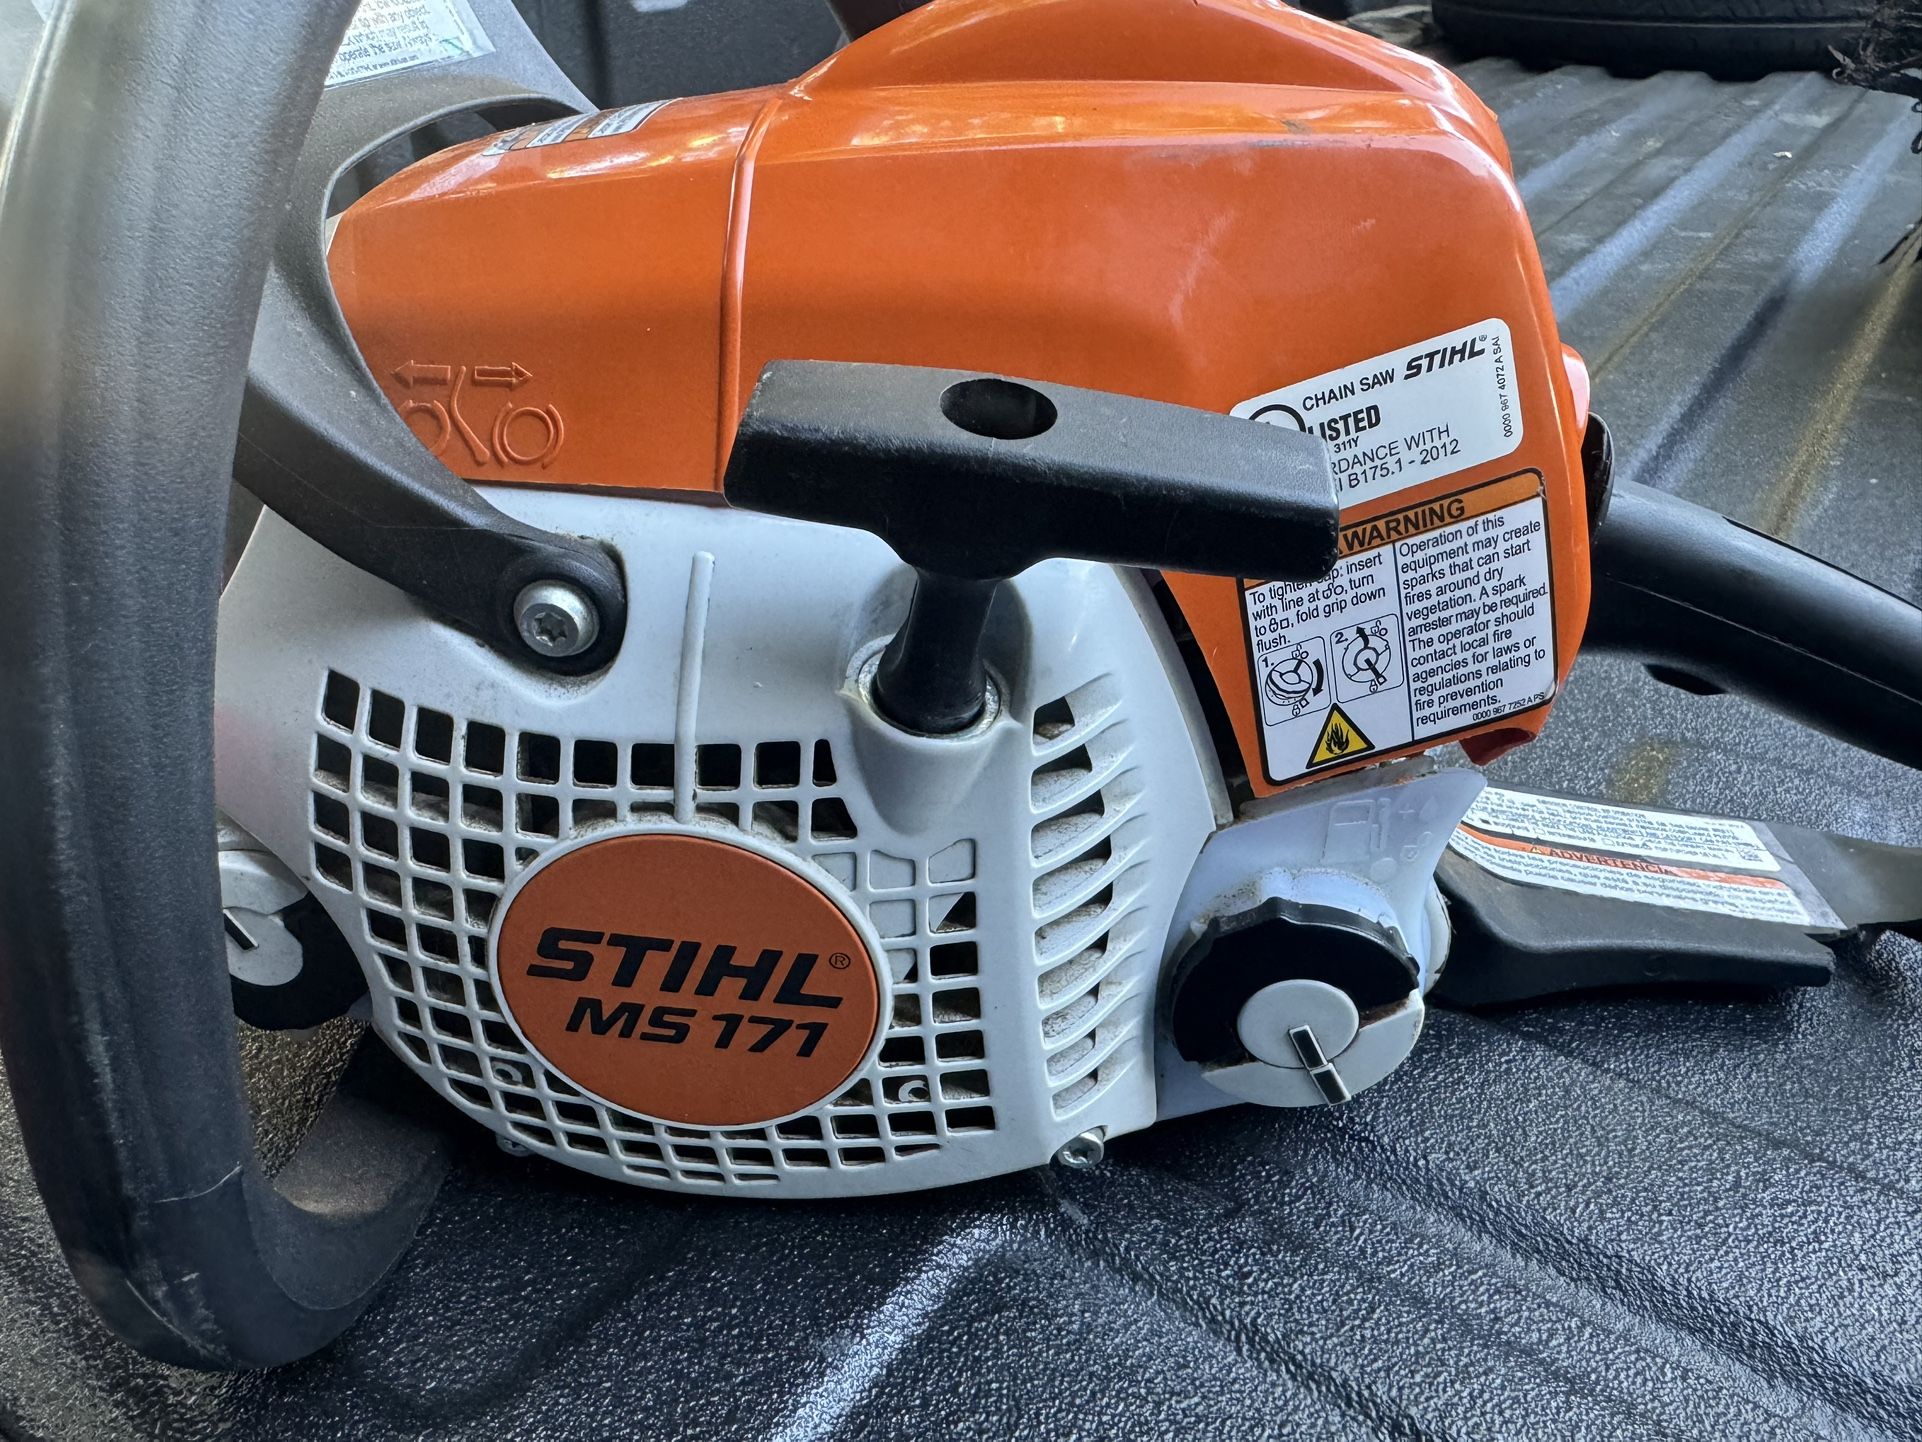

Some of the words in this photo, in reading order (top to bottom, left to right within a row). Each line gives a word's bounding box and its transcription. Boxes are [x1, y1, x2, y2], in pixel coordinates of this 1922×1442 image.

[1302, 382, 1355, 411] CHAIN
[1359, 368, 1396, 395] SAW
[1496, 365, 1506, 390] 4072
[1334, 436, 1360, 454] 311Y
[1404, 423, 1450, 451] WITH
[1502, 413, 1513, 438] 0000
[1348, 458, 1403, 489] B175.1
[1419, 438, 1461, 465] 2012
[1343, 499, 1466, 552] WARNING
[1399, 530, 1463, 558] Operation
[1466, 522, 1479, 537] of
[1482, 515, 1505, 531] this
[1401, 542, 1469, 573] equipment
[1472, 534, 1499, 553] may
[1502, 521, 1541, 543] create
[1249, 591, 1265, 605] To
[1346, 552, 1383, 575] insert
[1402, 567, 1446, 591] sparks
[1448, 557, 1474, 575] that
[1477, 551, 1500, 568] can
[1503, 539, 1531, 559] start
[1404, 589, 1432, 606] fires
[1436, 571, 1480, 597] around
[1484, 566, 1504, 582] dry
[1252, 602, 1278, 621] with
[1281, 597, 1304, 613] line
[1308, 588, 1321, 603] at
[1349, 574, 1374, 590] turn
[1254, 624, 1267, 637] to
[1296, 607, 1320, 625] fold
[1323, 598, 1347, 618] grip
[1351, 587, 1386, 606] down
[1406, 591, 1476, 622] vegetation.
[1479, 587, 1490, 601] A
[1491, 574, 1527, 597] spark
[1407, 614, 1453, 637] arrester
[1455, 606, 1481, 623] may
[1482, 601, 1498, 615] be
[1500, 583, 1549, 612] required.
[1256, 633, 1291, 653] flush.
[1409, 636, 1434, 652] The
[1437, 620, 1491, 646] operator
[1494, 604, 1535, 627] should
[1411, 643, 1457, 668] contact
[1460, 633, 1489, 650] local
[1493, 628, 1513, 643] fire
[1412, 658, 1469, 683] agencies
[1471, 651, 1489, 665] for
[1492, 642, 1520, 659] laws
[1523, 636, 1537, 649] or
[1413, 671, 1483, 697] regulations
[1486, 653, 1531, 675] relating
[1534, 648, 1546, 661] to
[1414, 698, 1434, 712] fire
[1438, 677, 1504, 709] prevention
[1416, 694, 1501, 727] requirements.
[1472, 710, 1491, 722] 0000
[565, 997, 698, 1045] MS
[712, 1013, 829, 1057] 171
